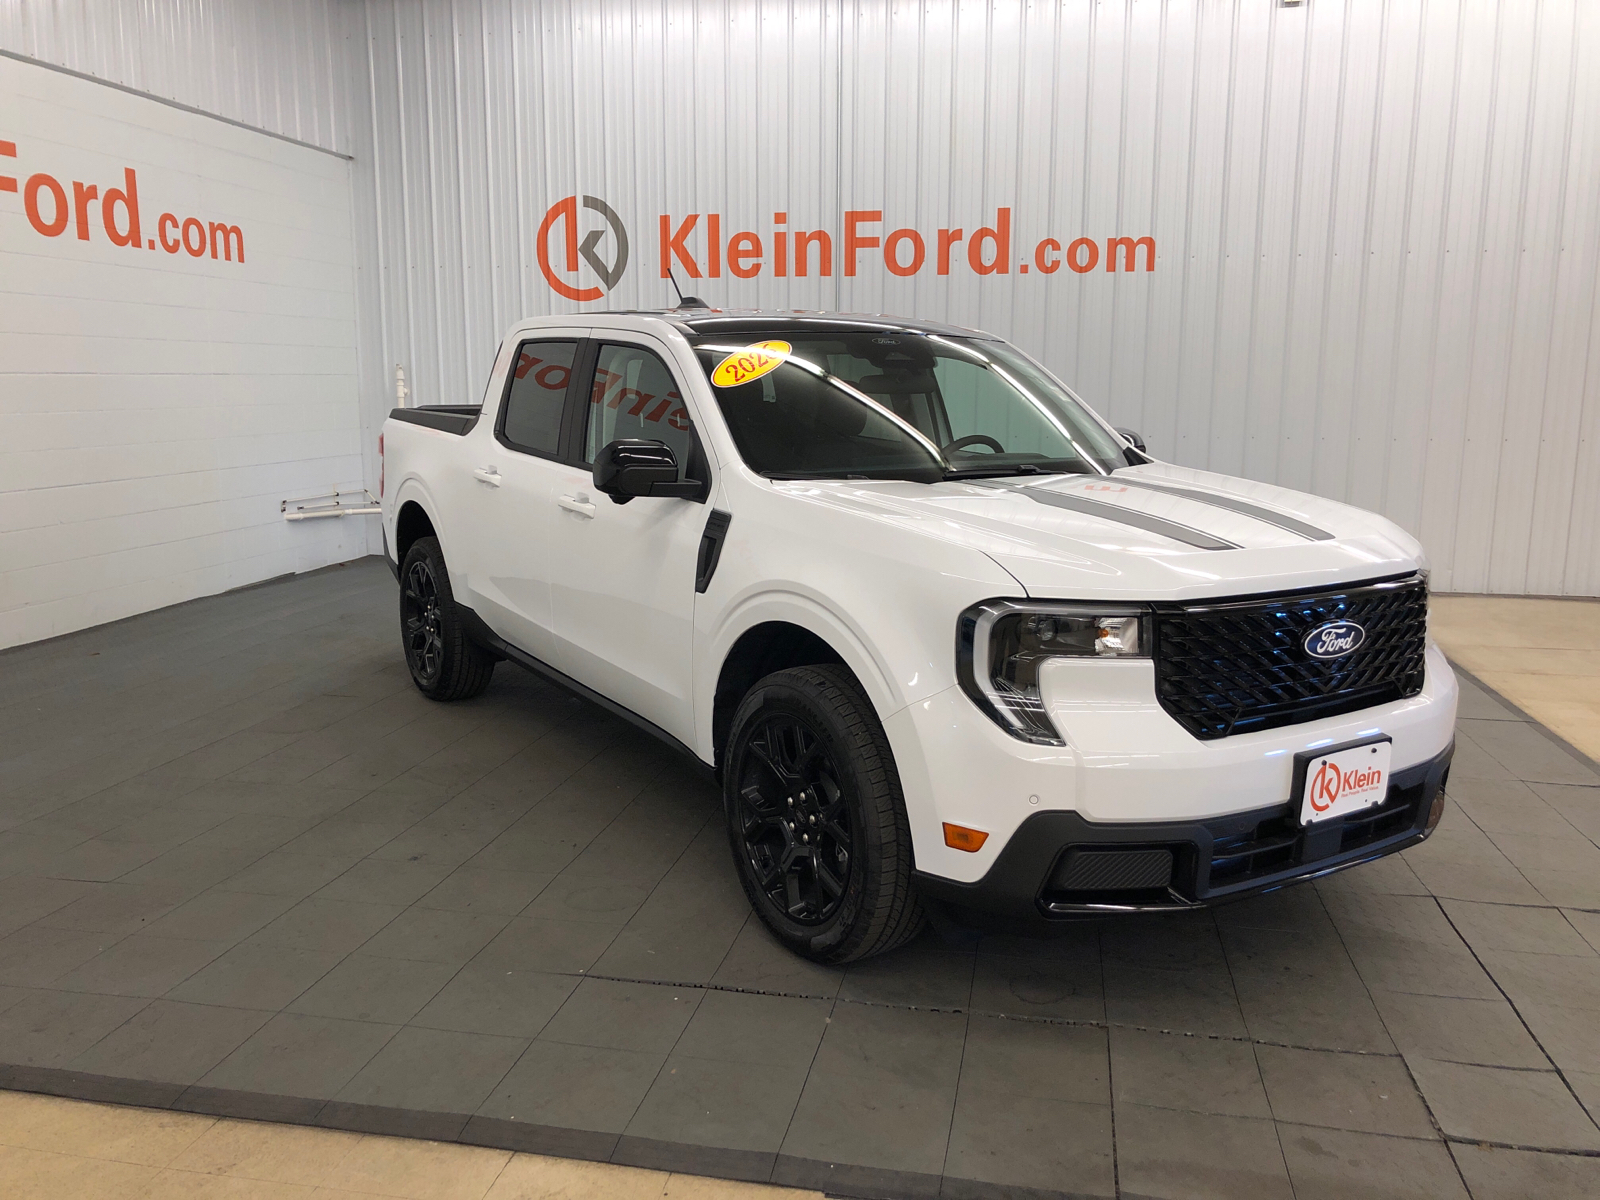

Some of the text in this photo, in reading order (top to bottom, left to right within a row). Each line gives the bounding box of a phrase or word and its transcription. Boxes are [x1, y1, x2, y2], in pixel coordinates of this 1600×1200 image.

[659, 207, 1156, 279] KleinFord.com
[1316, 627, 1355, 653] Ford
[1342, 766, 1382, 792] Klein
